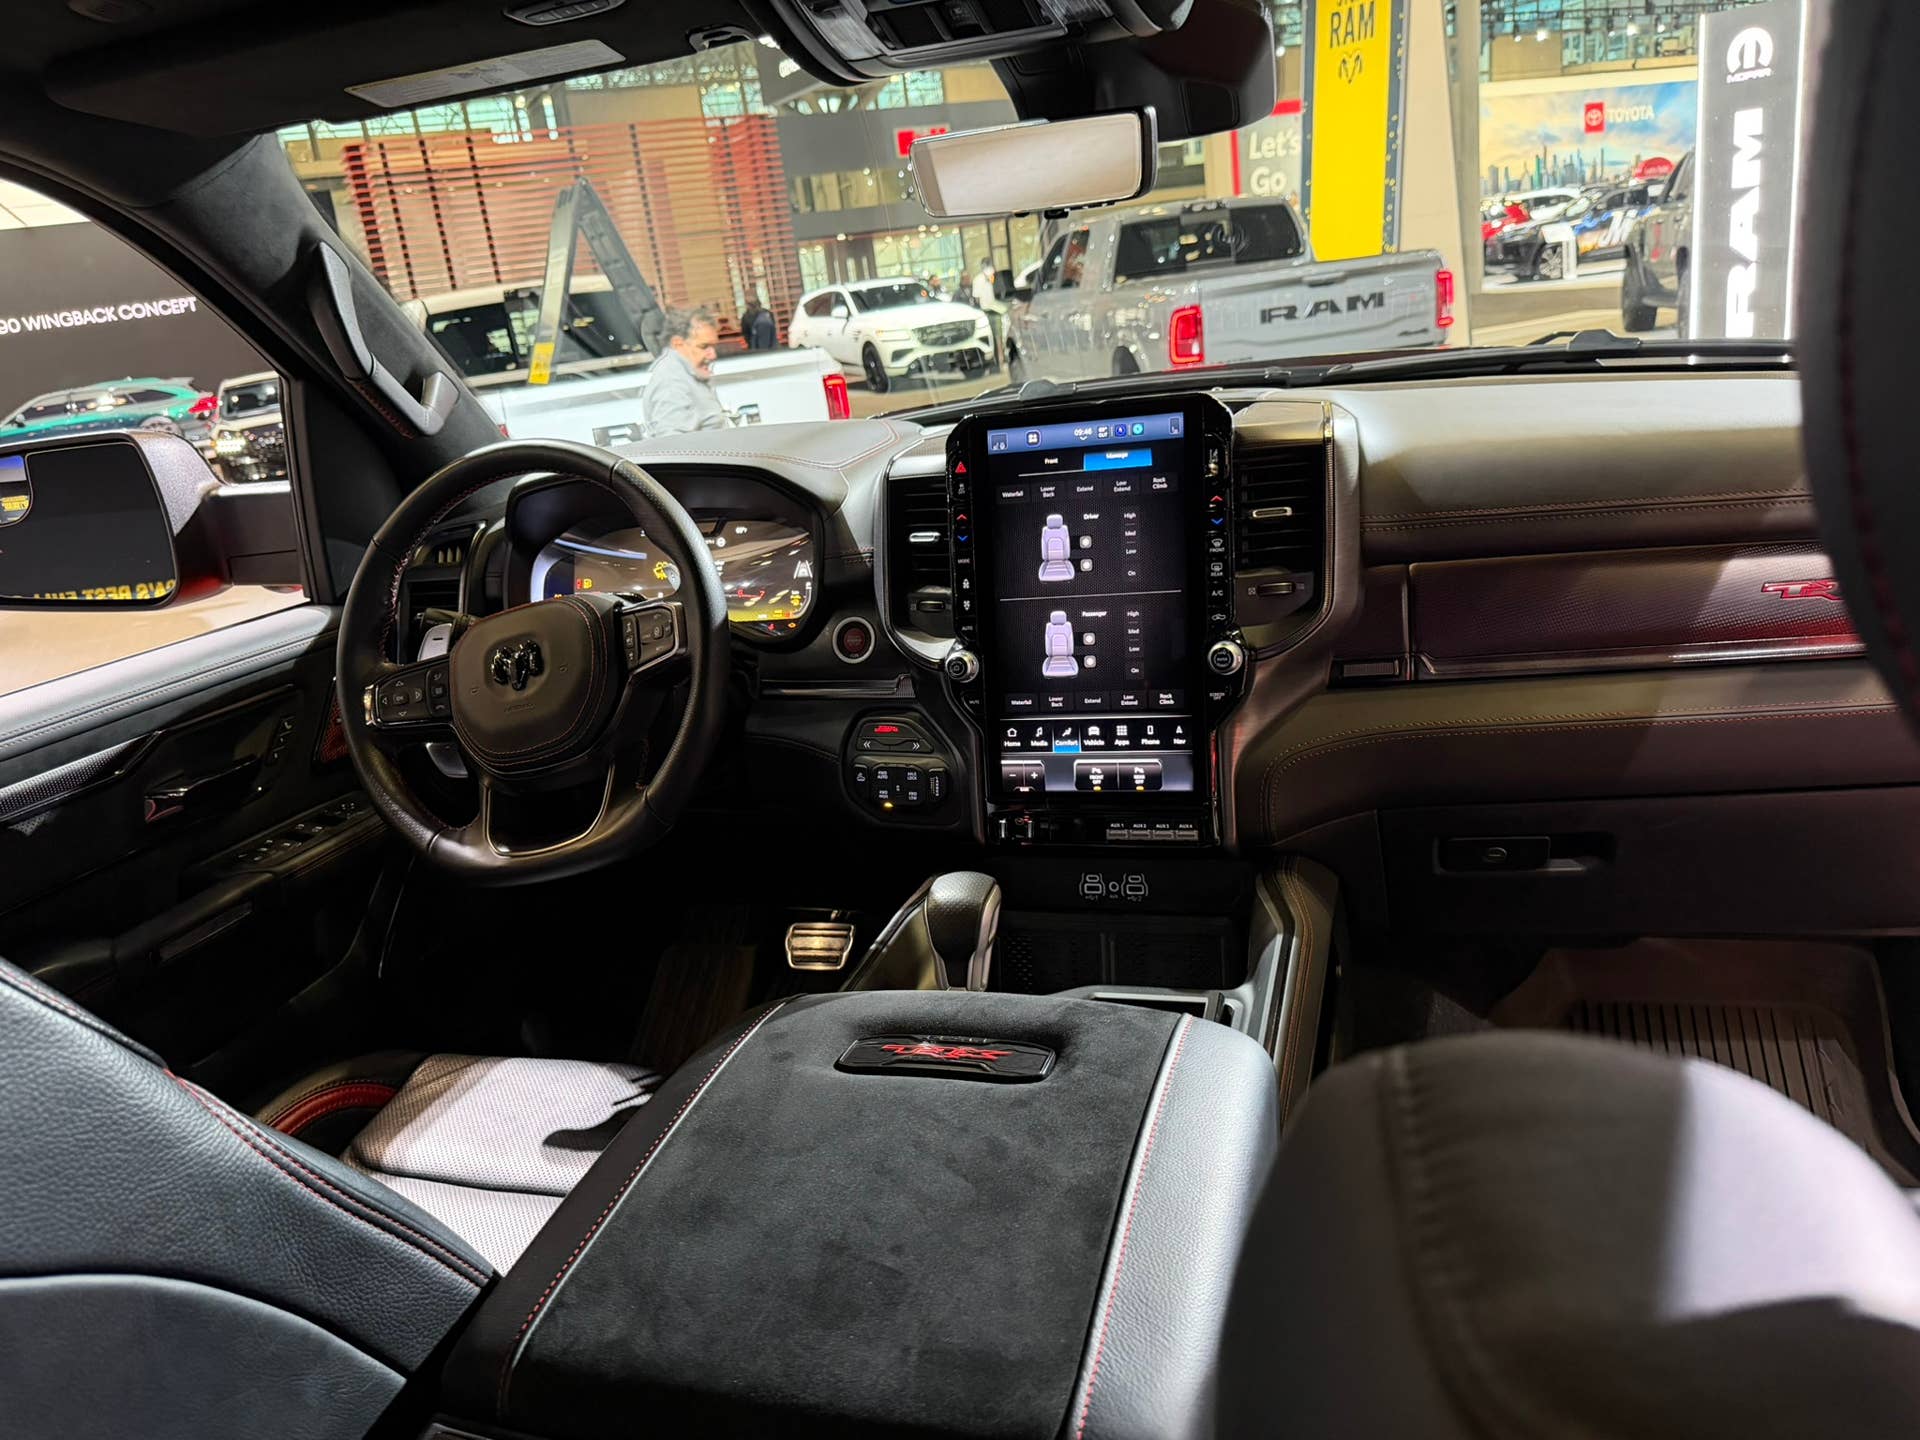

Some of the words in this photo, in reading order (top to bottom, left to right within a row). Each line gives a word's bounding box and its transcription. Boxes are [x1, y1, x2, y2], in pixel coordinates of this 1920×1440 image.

[1330, 1, 1375, 49] RAM
[1726, 68, 1773, 83] MOPAR
[1608, 105, 1655, 123] TOYOTA
[1249, 128, 1301, 160] Let's
[1251, 166, 1288, 196] Go
[1725, 108, 1763, 338] RAM
[22, 306, 118, 331] WINGBACK
[118, 296, 197, 320] CONCEPT
[1260, 292, 1385, 324] RAM
[1114, 739, 1130, 747] Apps
